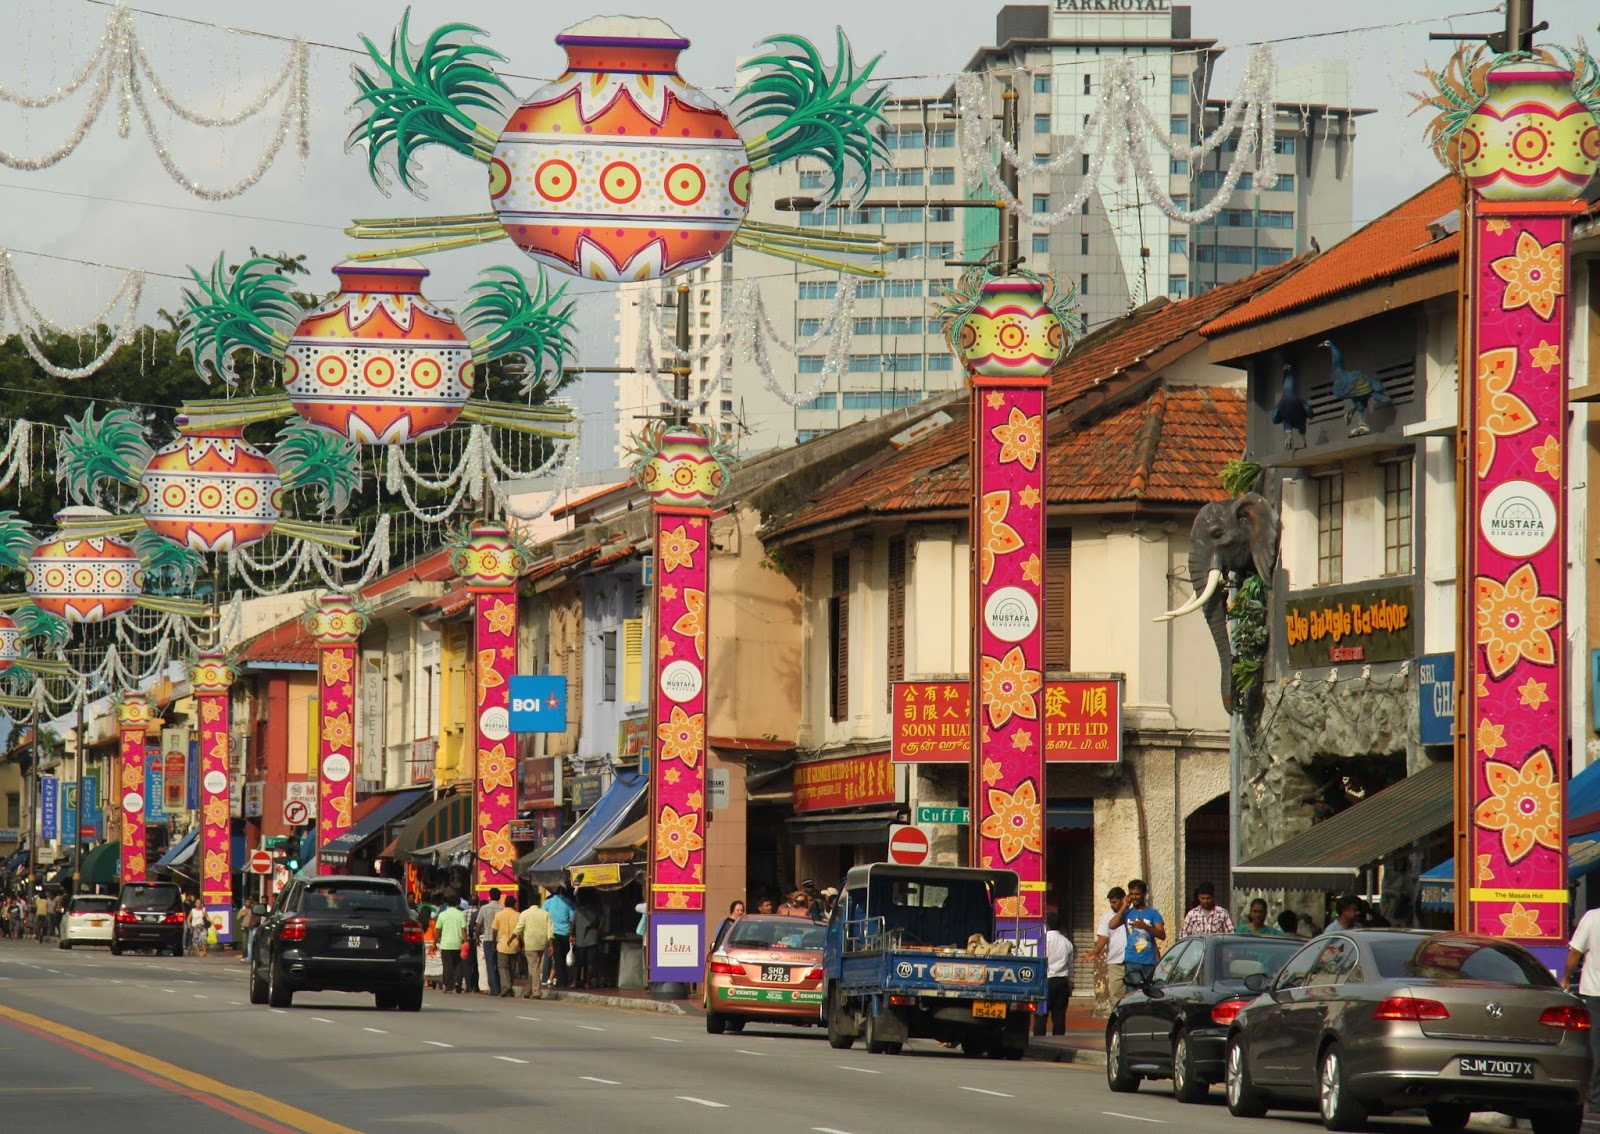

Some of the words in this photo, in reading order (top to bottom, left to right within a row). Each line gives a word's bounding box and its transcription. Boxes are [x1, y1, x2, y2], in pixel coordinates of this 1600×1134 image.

[1056, 0, 1169, 10] PARKROYAL
[1491, 519, 1544, 529] MUSTAFA
[992, 614, 1030, 622] MUSTAFA
[1286, 608, 1308, 645] The
[1310, 603, 1351, 642] Jungle
[1351, 599, 1408, 635] Tandoor
[1420, 664, 1436, 684] SRI
[512, 698, 540, 712] BOI
[368, 677, 378, 773] SHEETAL
[901, 723, 936, 737] SOON
[1057, 722, 1080, 736] PTE
[1085, 722, 1109, 736] LTD
[46, 780, 54, 825] INTERNET
[922, 809, 956, 822] Cuff
[768, 967, 784, 975] SHD
[901, 964, 909, 973] 70
[1021, 969, 1031, 978] 10
